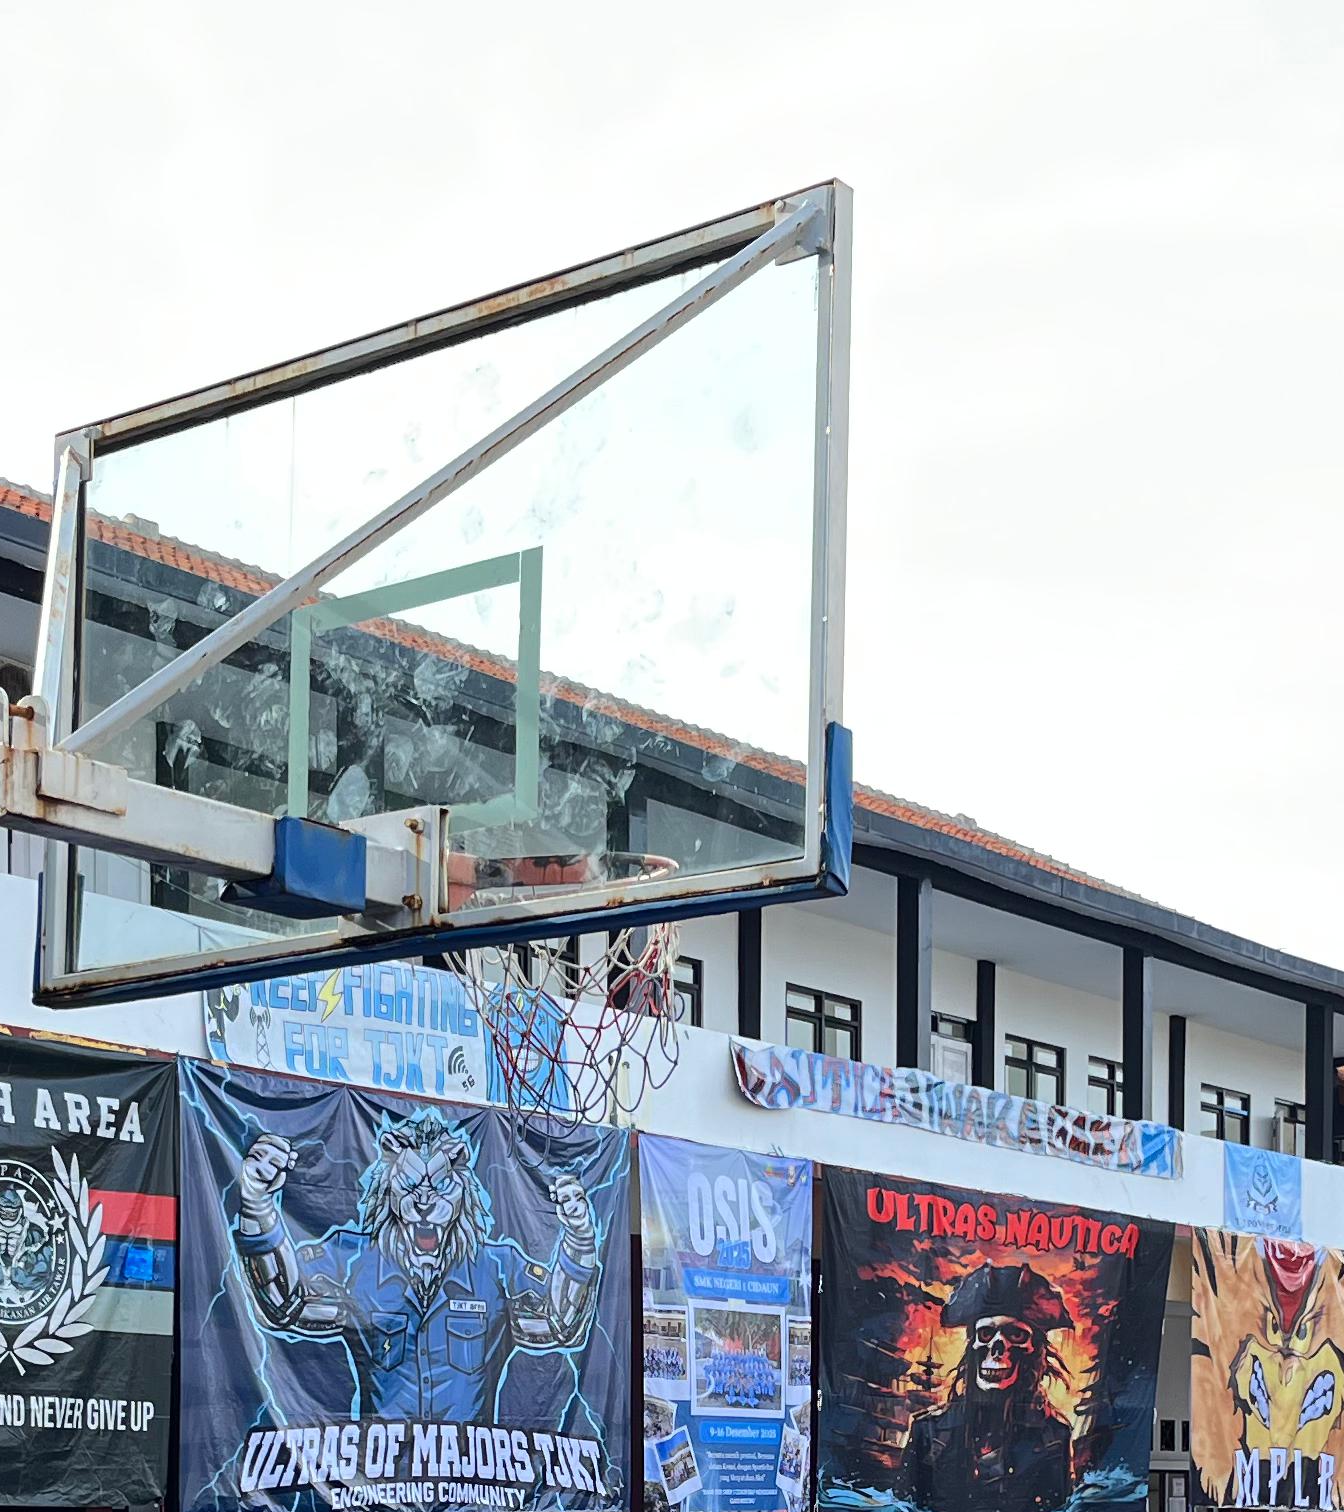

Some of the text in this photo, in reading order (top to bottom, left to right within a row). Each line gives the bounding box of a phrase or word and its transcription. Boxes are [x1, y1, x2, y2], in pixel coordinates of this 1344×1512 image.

[343, 962, 479, 1037] FIGHTING
[282, 1020, 449, 1096] FOR TJKT
[34, 1087, 145, 1143] AREA
[687, 1172, 777, 1264] OSIS
[866, 1187, 1140, 1260] ULTRAS NAUTICA
[38, 1293, 53, 1311] AIR
[693, 1275, 713, 1289] SMK
[713, 1276, 742, 1291] NEGERI
[747, 1279, 779, 1295] CIDAUN
[30, 1396, 83, 1430] NEVER
[86, 1399, 127, 1431] GIVE
[130, 1401, 155, 1432] UP
[240, 1423, 606, 1496] ULTRAS OF MAJORS TJKT
[331, 1481, 526, 1511] ENGINEERING COMMUNITY
